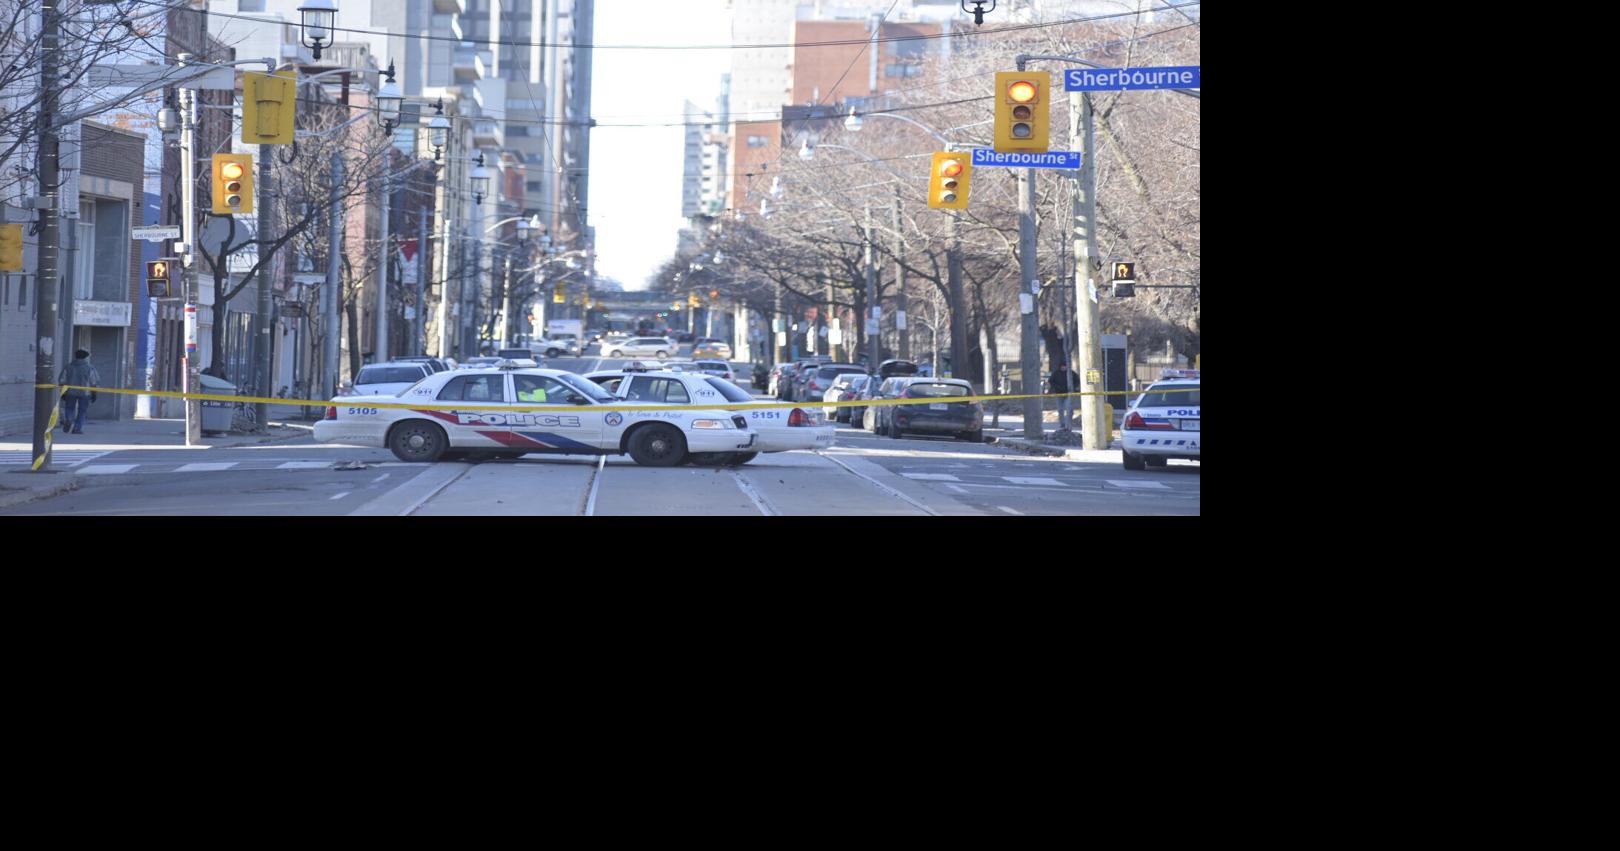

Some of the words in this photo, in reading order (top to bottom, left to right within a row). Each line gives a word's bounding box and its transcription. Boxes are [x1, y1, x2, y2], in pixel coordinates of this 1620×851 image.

[1070, 70, 1193, 87] Sherbourne
[976, 150, 1066, 165] Sherbourne
[348, 407, 378, 415] 5105
[752, 411, 780, 419] 5151
[457, 412, 580, 427] POLICE
